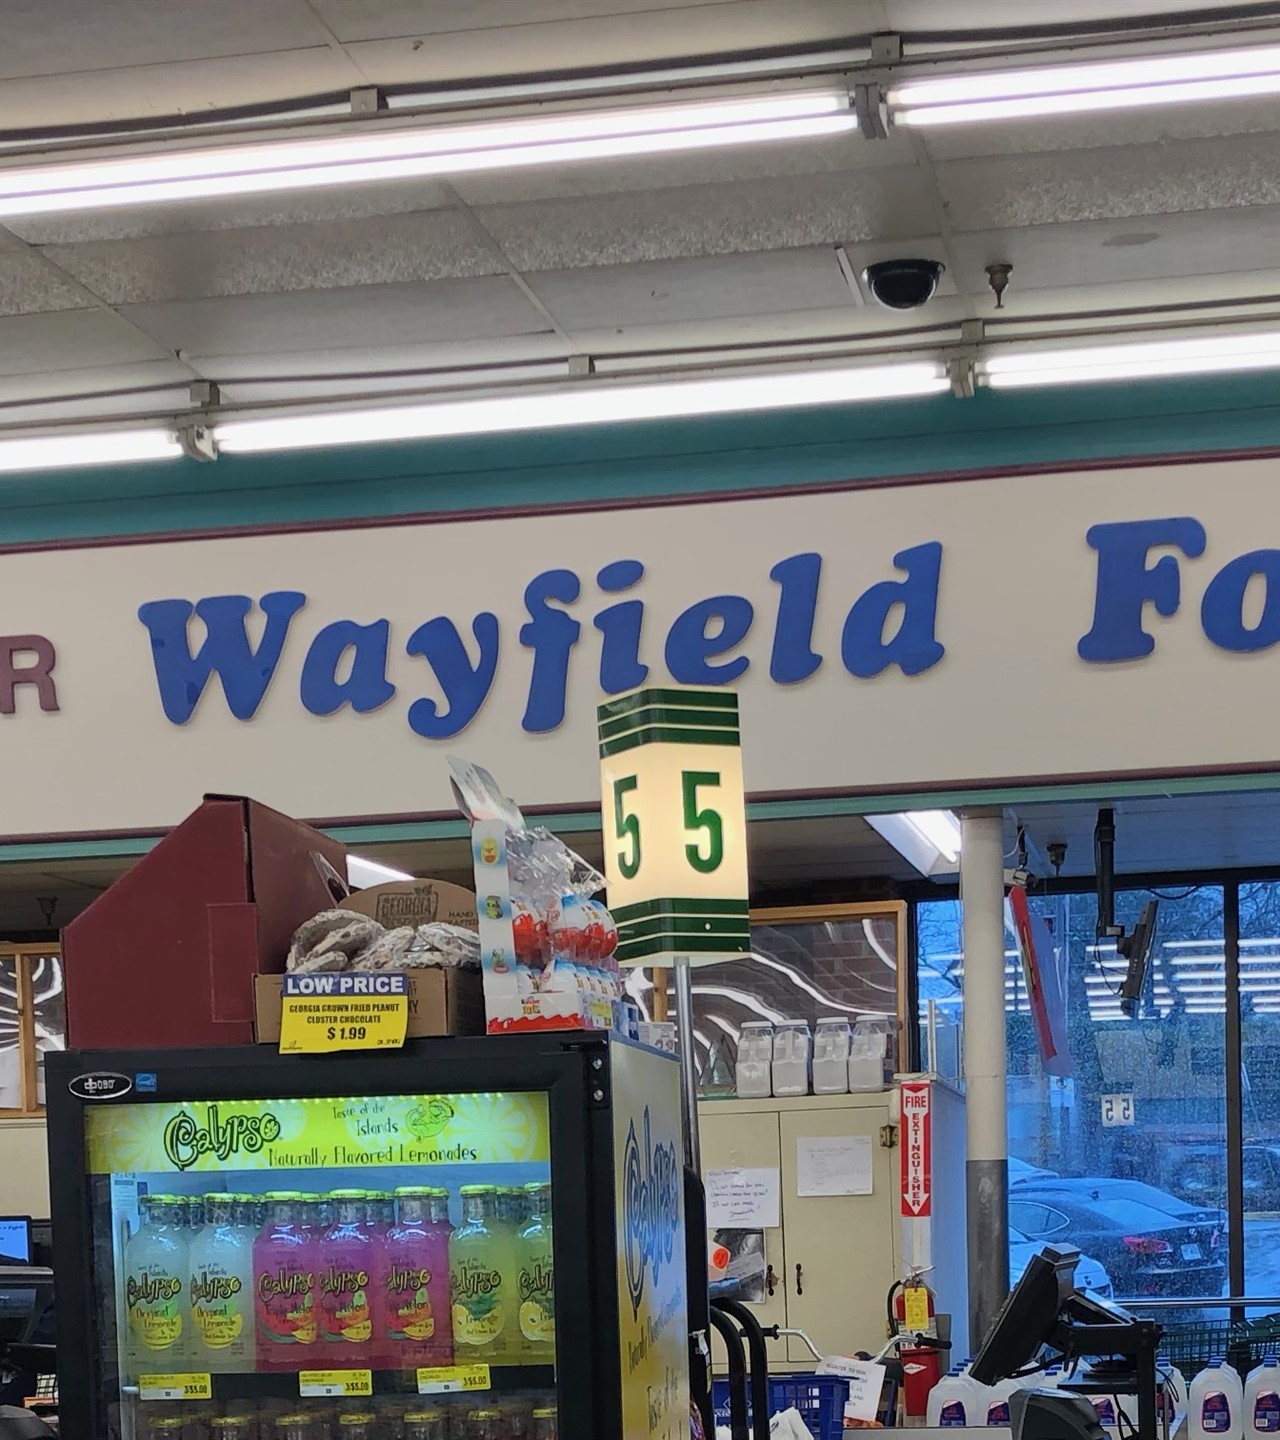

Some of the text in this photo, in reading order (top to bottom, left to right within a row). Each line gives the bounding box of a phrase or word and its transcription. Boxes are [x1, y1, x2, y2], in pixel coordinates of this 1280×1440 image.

[138, 540, 946, 741] Wayfield
[614, 773, 642, 880] 5
[683, 770, 725, 875] 5
[287, 975, 404, 994] LOW PRICE
[289, 1004, 320, 1013] GEORGIA
[905, 1096, 926, 1109] FIRE
[163, 1105, 281, 1172] Calypso
[359, 1104, 369, 1116] of
[355, 1117, 399, 1137] Islands
[269, 1143, 478, 1167] Naturally Flavored Lemonades
[911, 1113, 921, 1206] EXTINGUISHER
[387, 1265, 432, 1293] alypso
